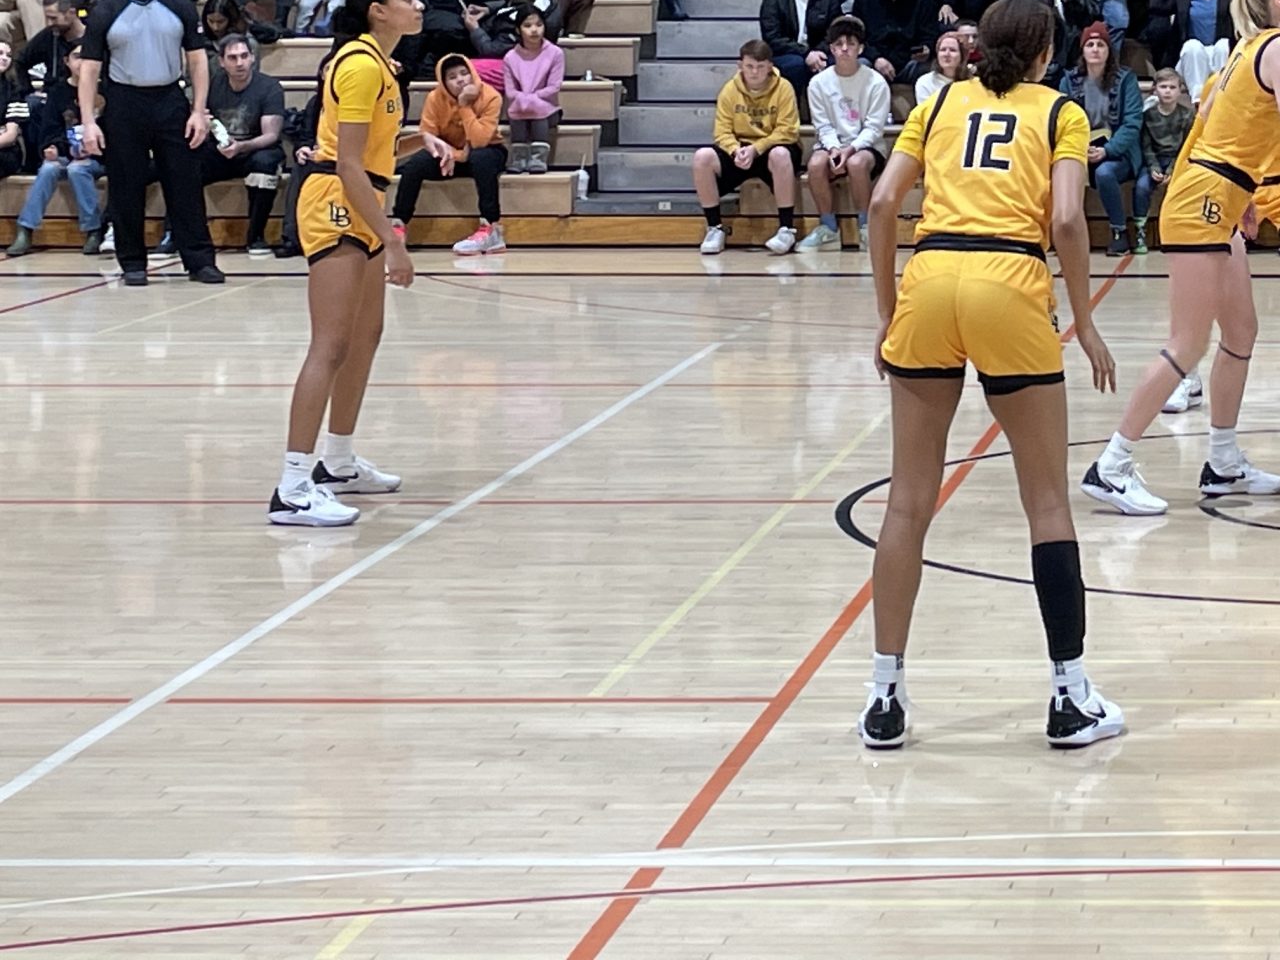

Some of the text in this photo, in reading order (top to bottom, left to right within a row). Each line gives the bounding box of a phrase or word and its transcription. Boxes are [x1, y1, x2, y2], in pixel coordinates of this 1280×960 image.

[963, 112, 1017, 170] 12
[328, 199, 351, 228] LB
[1202, 194, 1221, 225] LB
